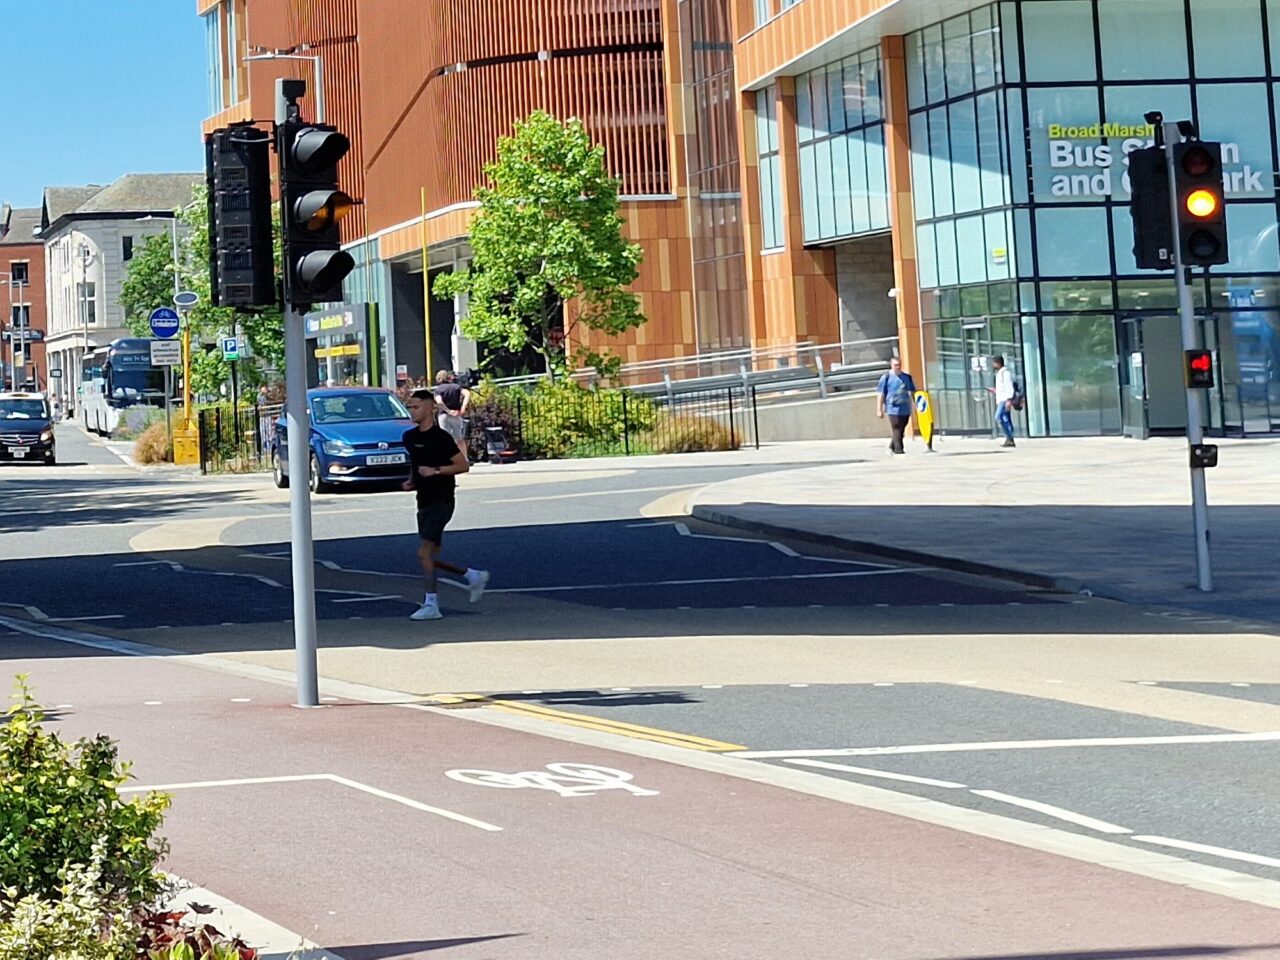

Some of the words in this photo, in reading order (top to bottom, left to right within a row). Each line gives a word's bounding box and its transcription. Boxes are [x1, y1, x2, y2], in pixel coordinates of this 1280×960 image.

[1048, 124, 1098, 138] Broad
[1049, 140, 1113, 168] Bus
[1051, 168, 1112, 196] and
